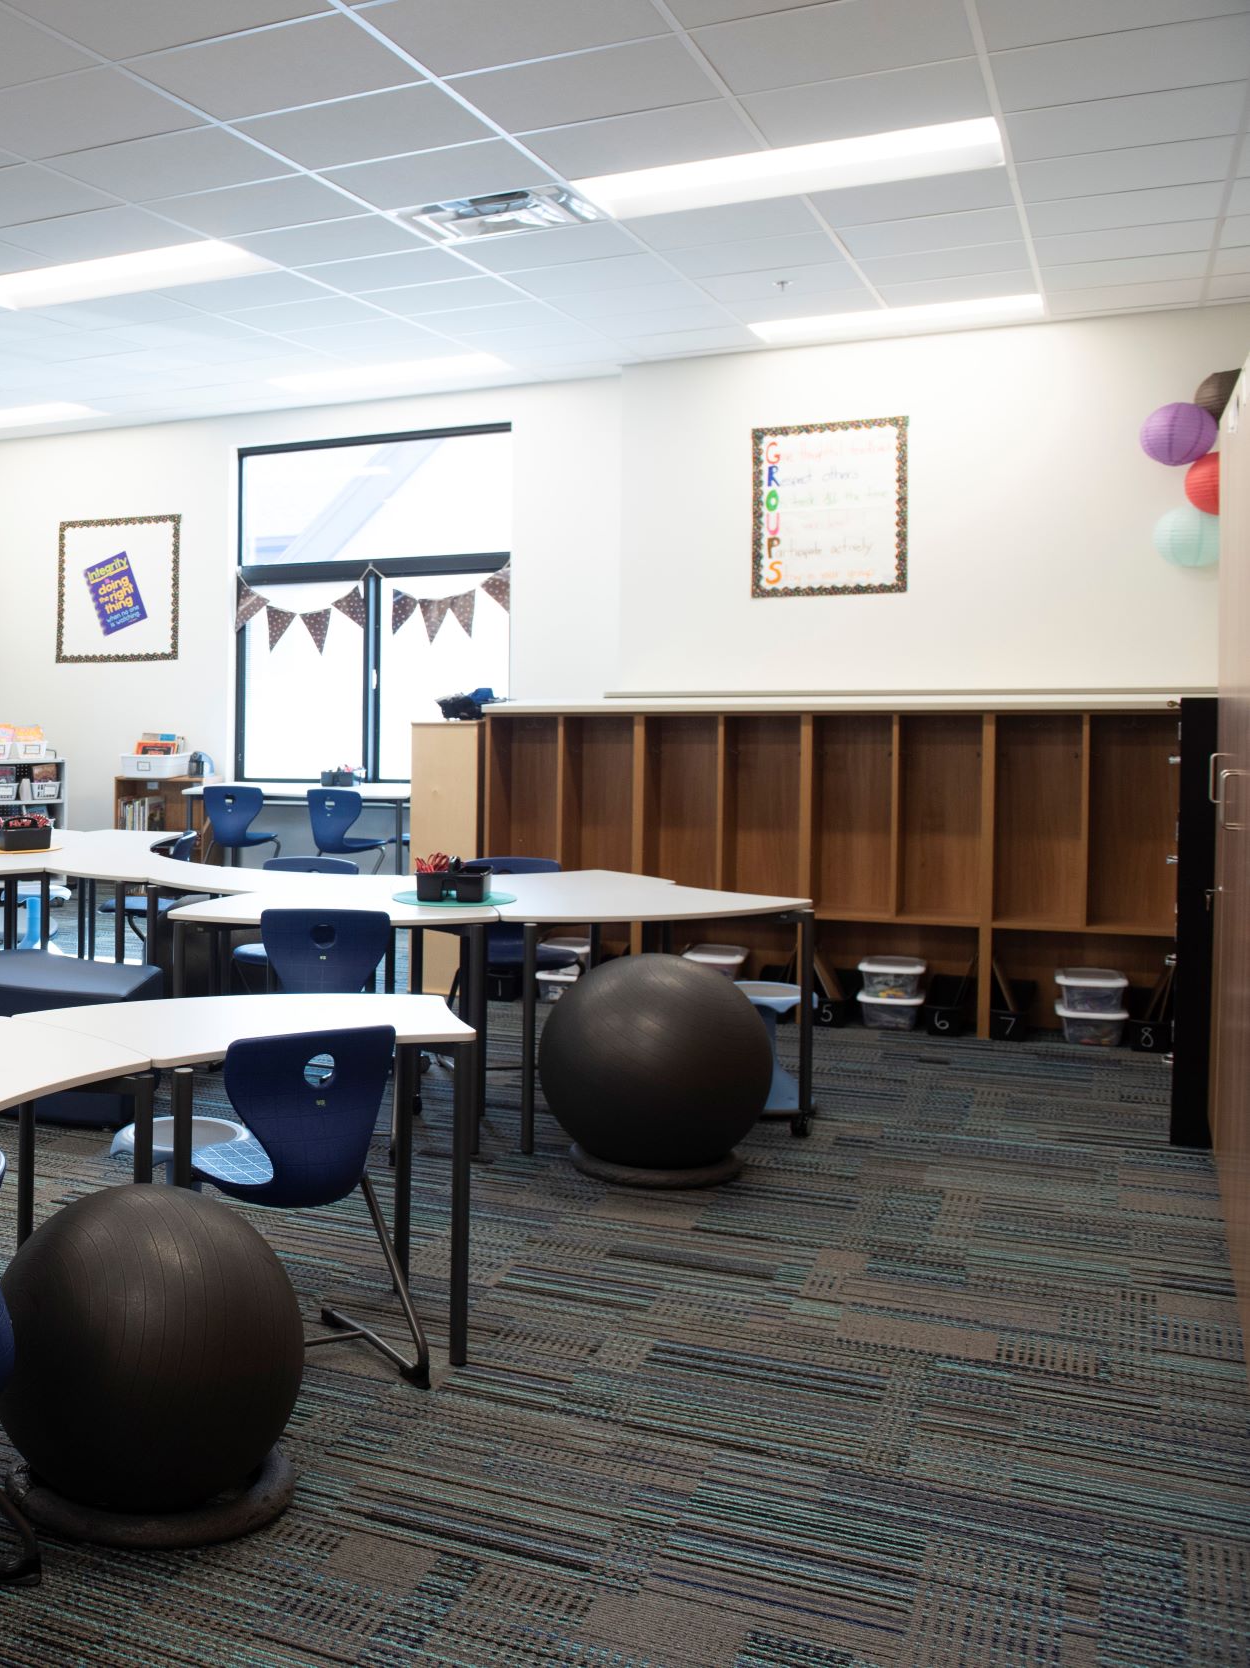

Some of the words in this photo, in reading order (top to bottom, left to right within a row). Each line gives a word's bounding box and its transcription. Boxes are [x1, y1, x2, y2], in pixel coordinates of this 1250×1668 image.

[98, 576, 130, 595] doing
[109, 584, 134, 602] right
[105, 596, 133, 614] thing
[820, 1004, 833, 1022] 5
[934, 1010, 949, 1030] 6
[1000, 1016, 1015, 1035] 7
[1141, 1027, 1153, 1047] 8
